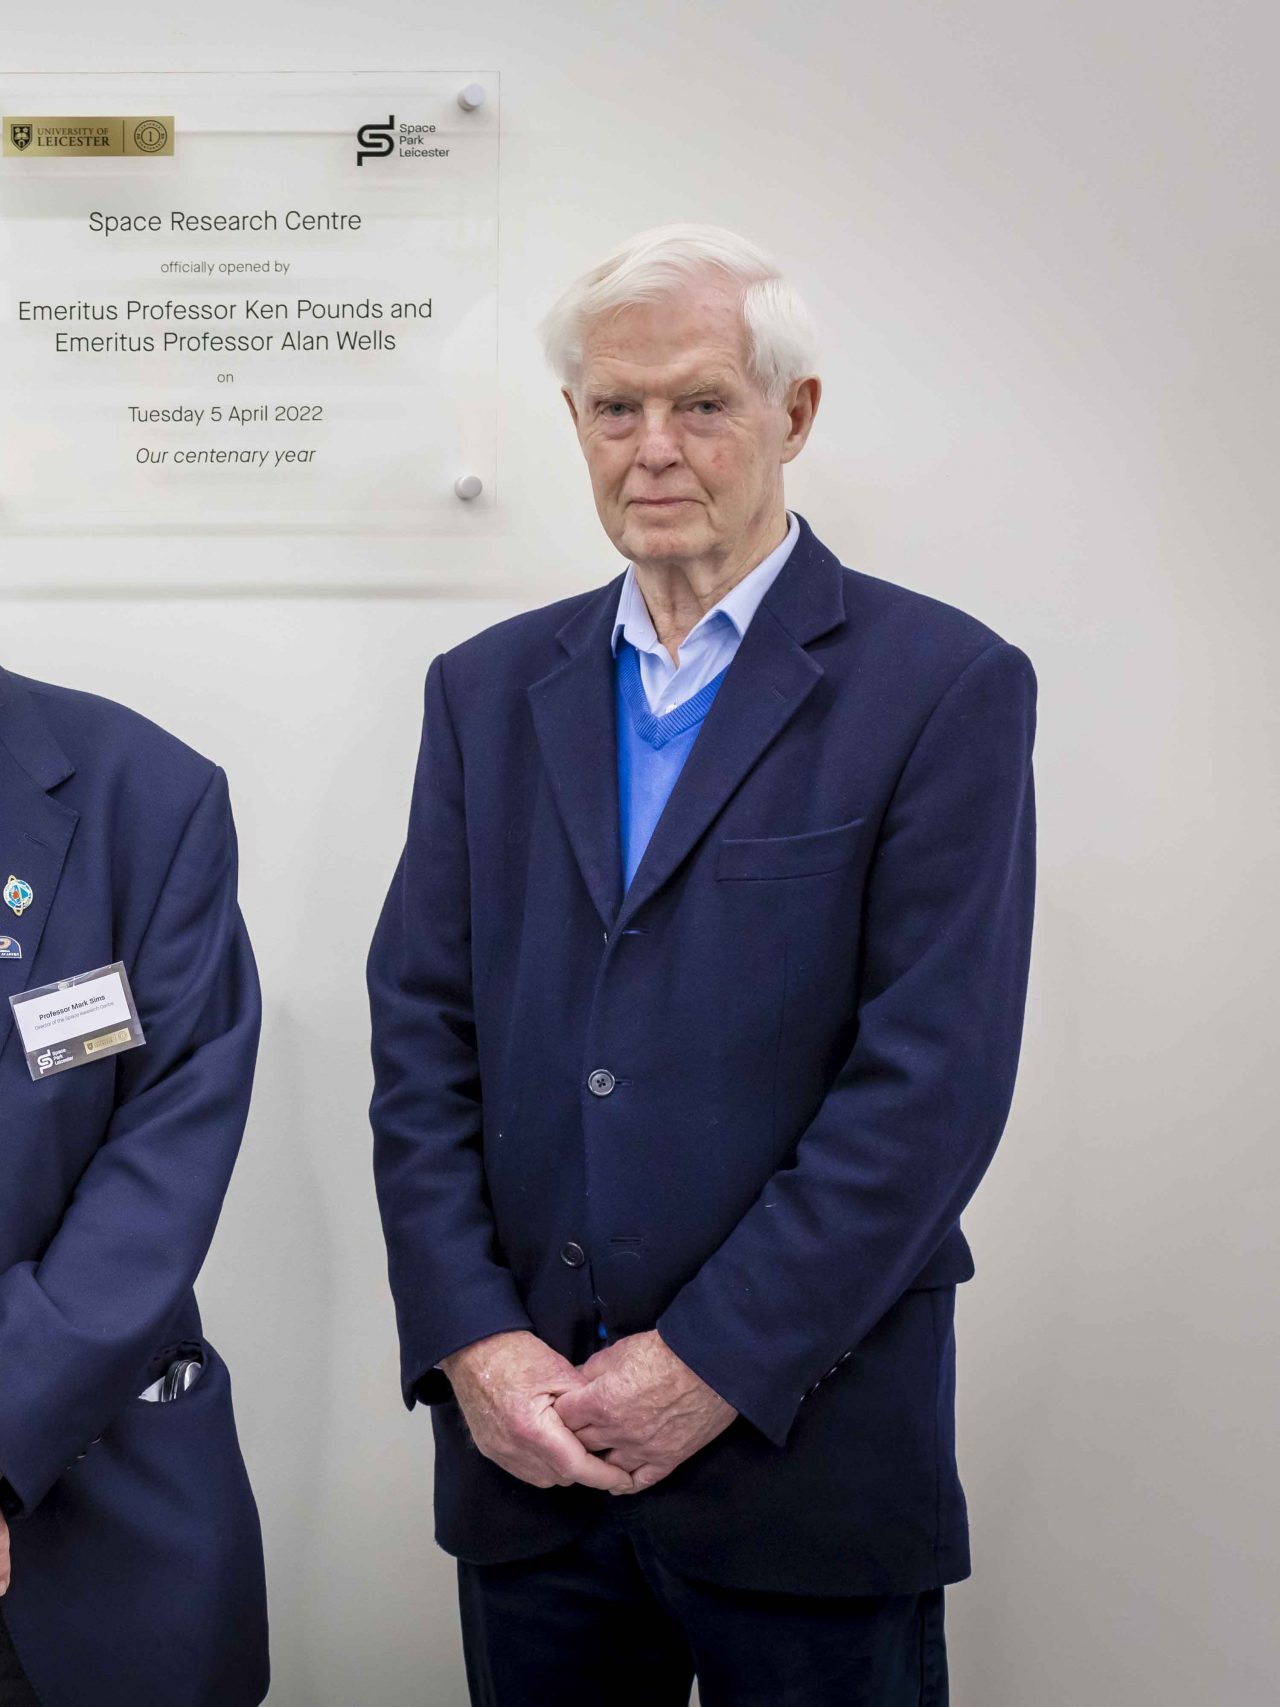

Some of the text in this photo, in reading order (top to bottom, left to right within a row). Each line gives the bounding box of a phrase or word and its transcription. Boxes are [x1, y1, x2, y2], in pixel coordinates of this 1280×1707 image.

[37, 127, 109, 135] UNIVERSITY OF
[399, 123, 436, 135] Space
[37, 136, 110, 147] LEICESTER
[399, 135, 424, 145] Park
[399, 147, 450, 157] Leicester
[88, 209, 362, 237] Space Research Centre
[160, 260, 291, 277] officially opened by
[18, 298, 432, 321] Emeritus Professor Ken Pounds and
[55, 330, 397, 353] Emeritus Professor Alan Wells
[216, 373, 235, 384] on
[127, 405, 324, 427] Tuesday 5 April 2022
[135, 447, 317, 468] Our centenary year
[39, 995, 105, 1020] Professor Mark Sims
